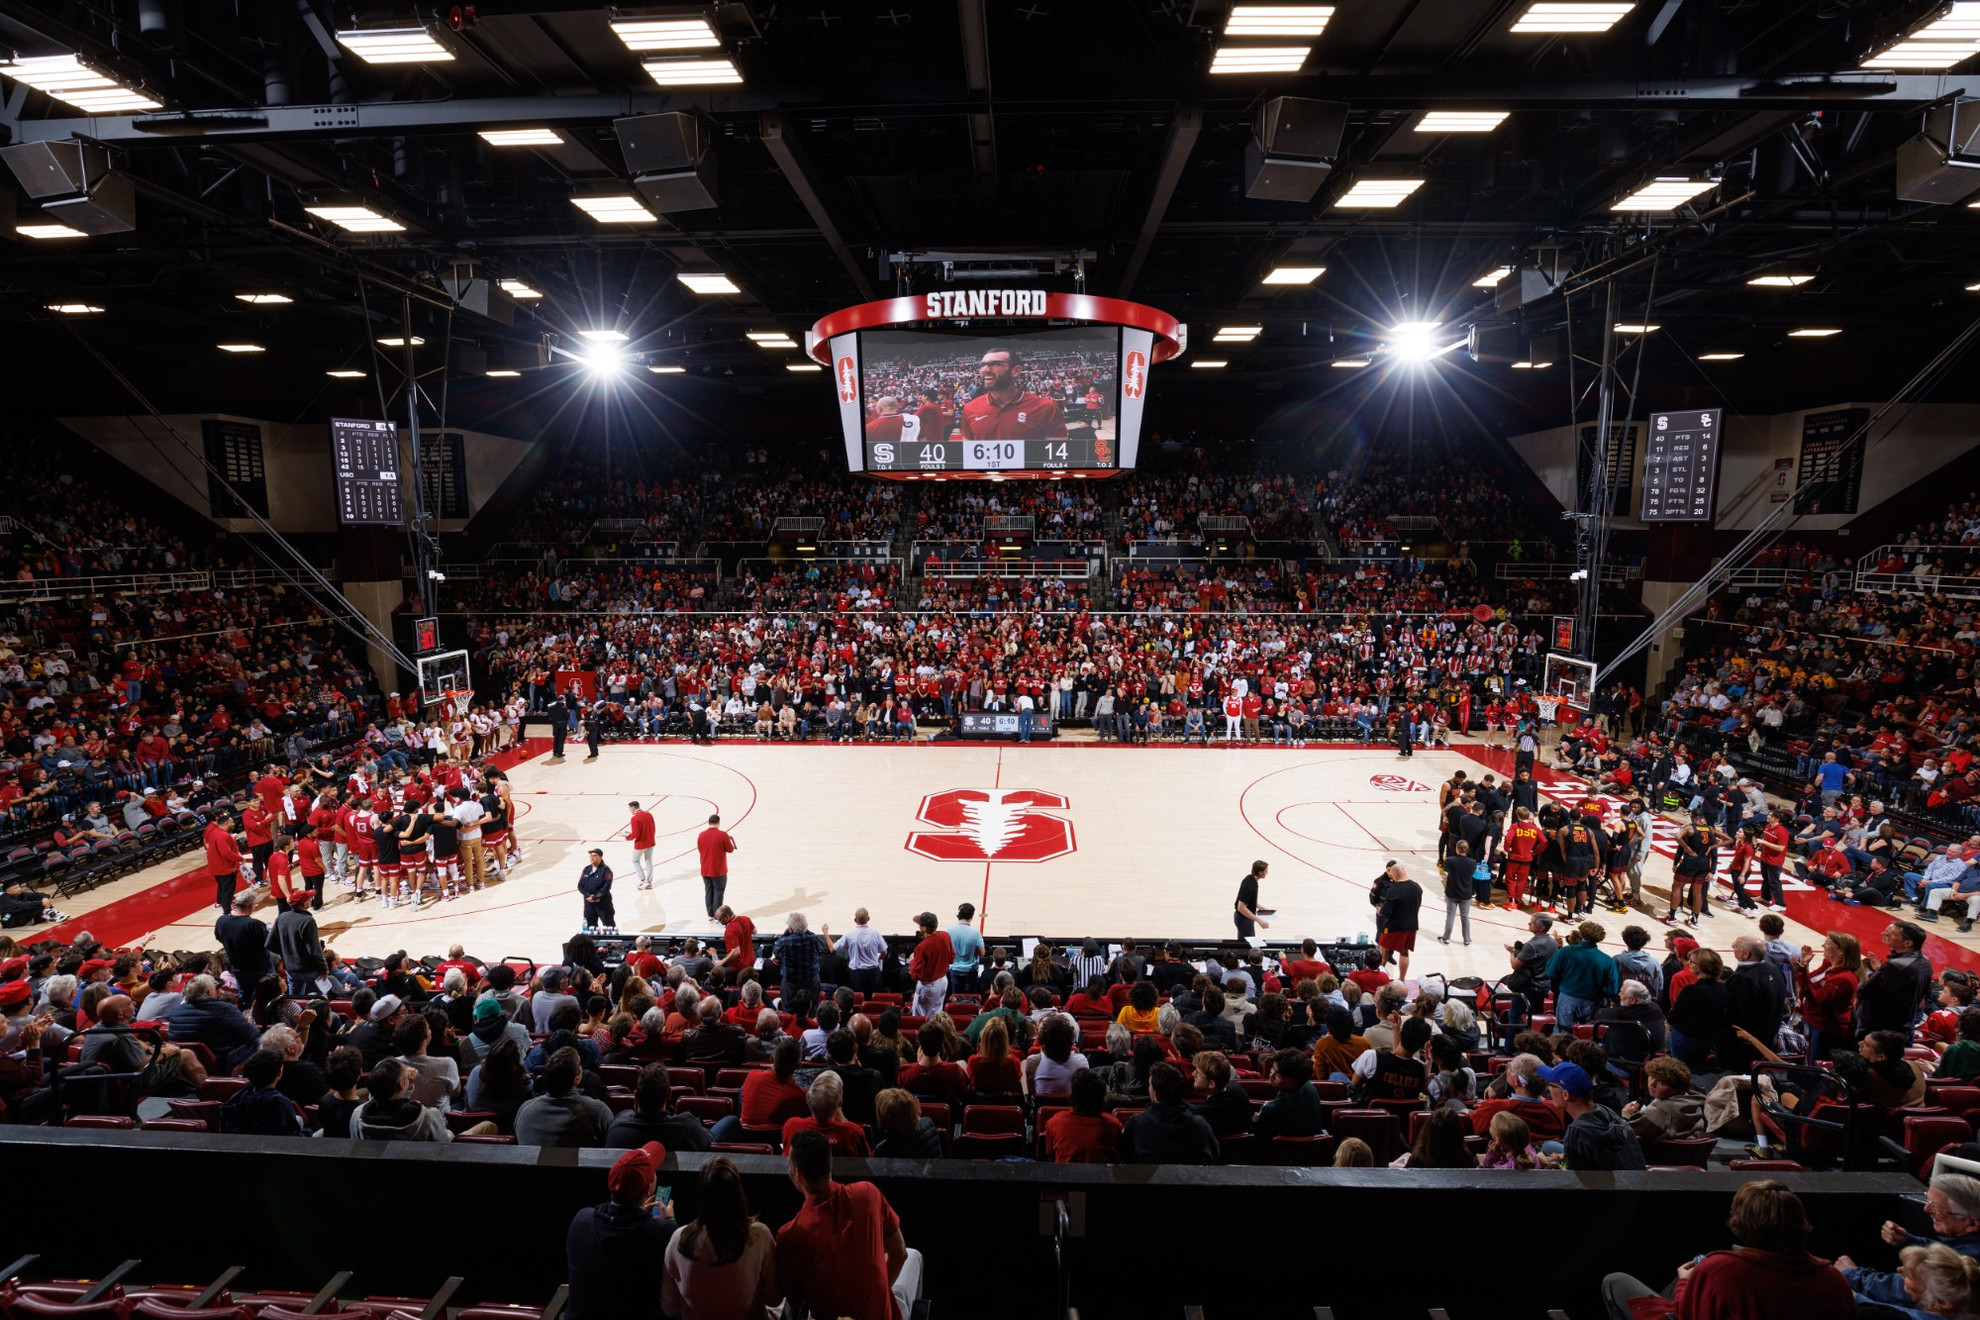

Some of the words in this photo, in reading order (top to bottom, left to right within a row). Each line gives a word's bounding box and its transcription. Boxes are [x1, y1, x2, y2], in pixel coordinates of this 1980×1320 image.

[927, 290, 1046, 317] STANFORD
[874, 443, 894, 464] S
[920, 444, 945, 462] 40
[974, 444, 1014, 460] 6:10
[1045, 442, 1068, 460] 14
[420, 632, 434, 650] 30
[1585, 802, 1600, 811] USC
[356, 822, 367, 833] 13
[1515, 828, 1537, 839] USC
[1573, 831, 1587, 843] 24
[1701, 832, 1709, 844] 3
